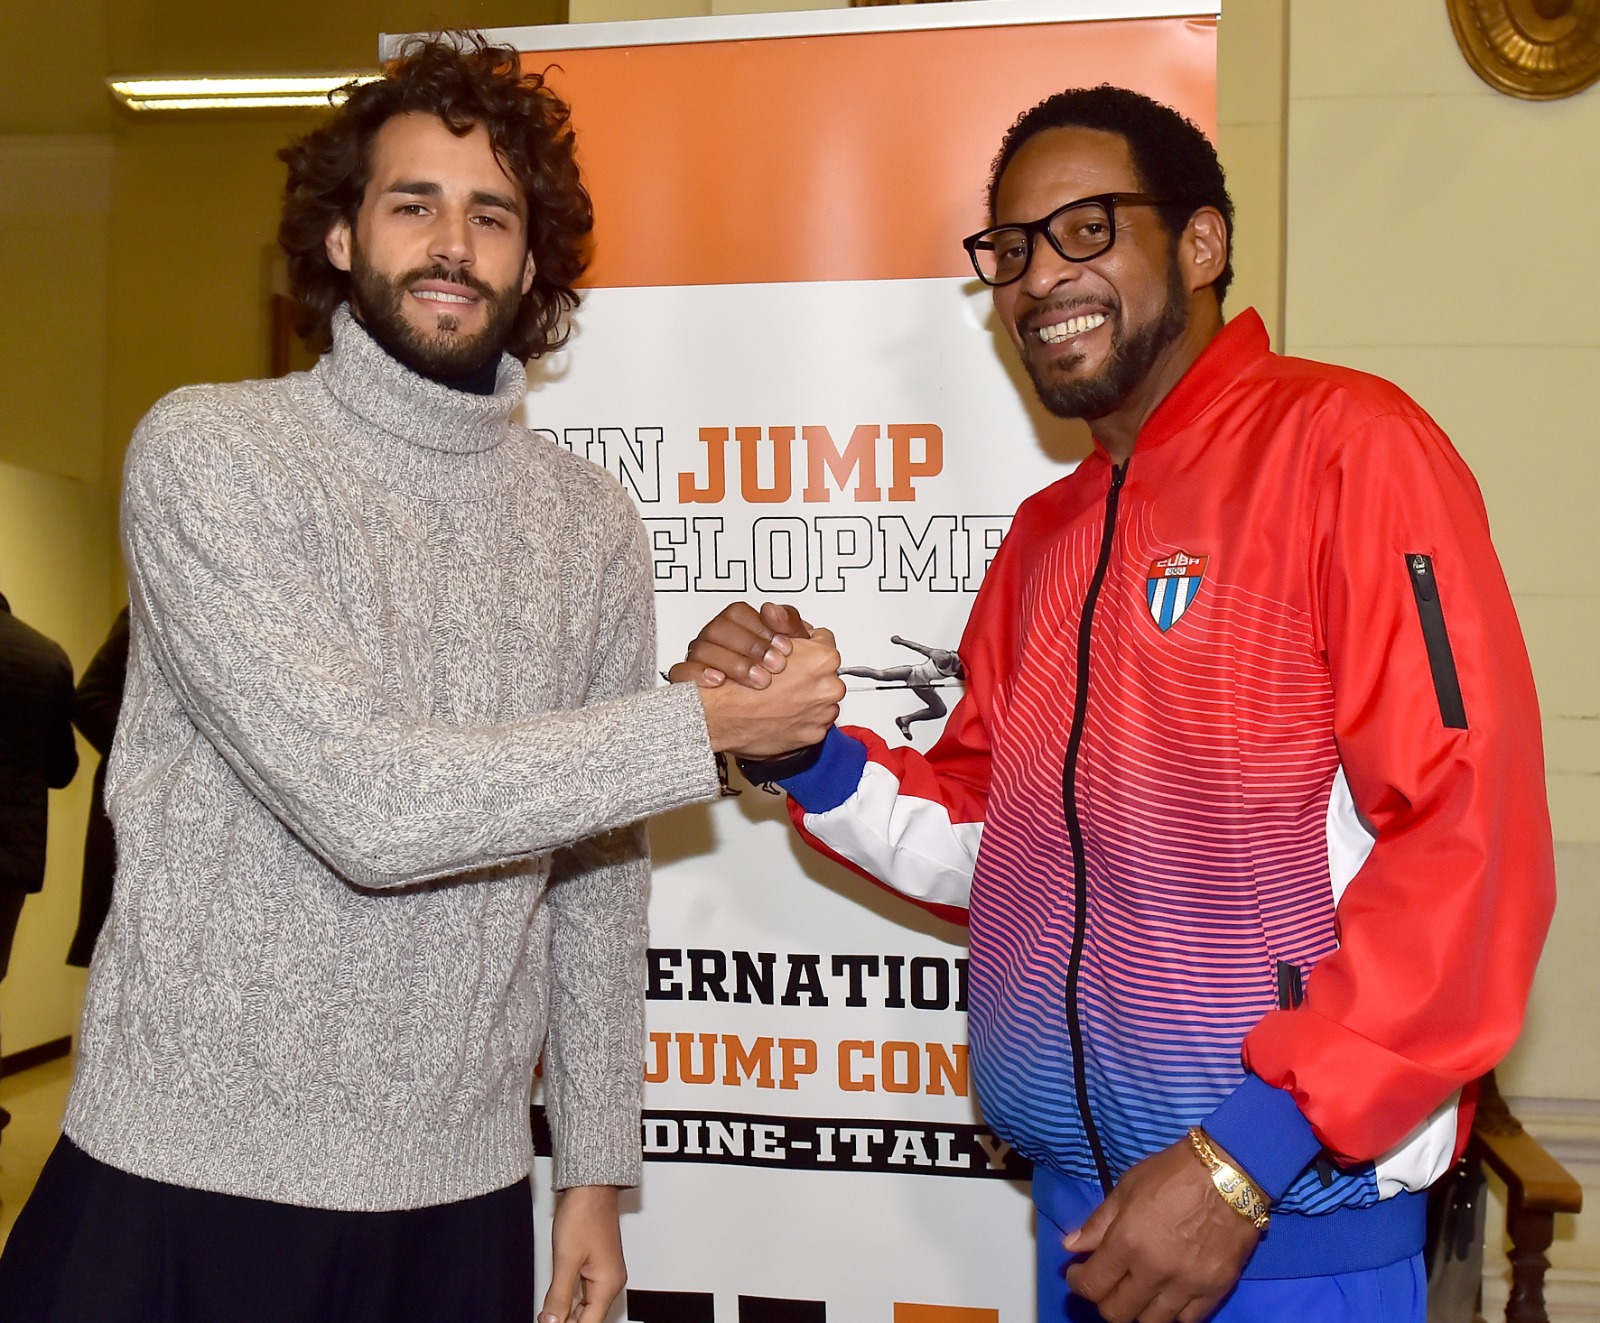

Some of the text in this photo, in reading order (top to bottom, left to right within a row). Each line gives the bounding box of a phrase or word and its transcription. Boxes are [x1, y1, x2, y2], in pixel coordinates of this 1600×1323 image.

[678, 423, 944, 504] JUMP
[1157, 553, 1200, 567] CUBA
[644, 1032, 818, 1090] JUMP
